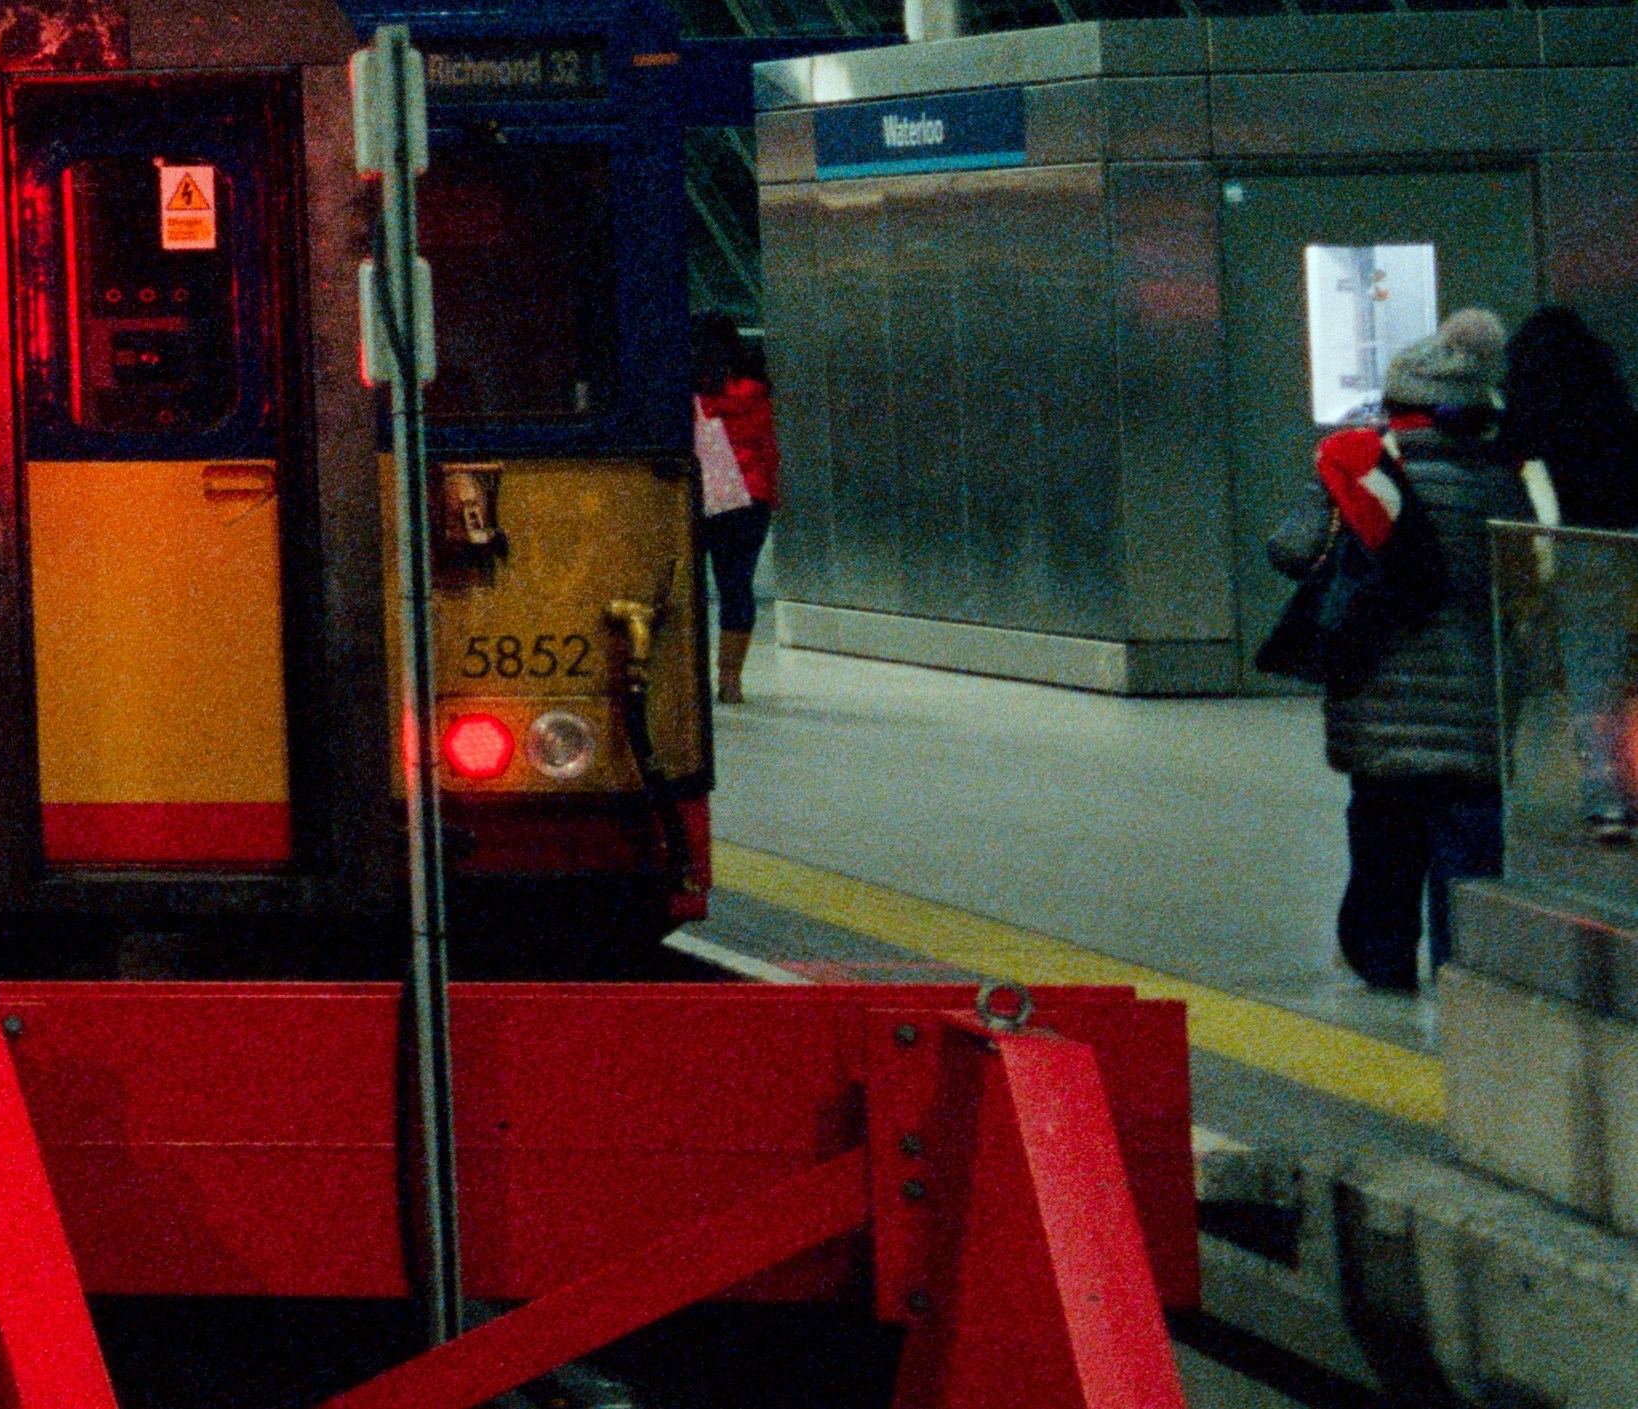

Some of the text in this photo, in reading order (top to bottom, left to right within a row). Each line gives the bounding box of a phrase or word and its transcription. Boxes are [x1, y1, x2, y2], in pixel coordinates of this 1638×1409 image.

[427, 51, 541, 86] Richmond
[882, 112, 944, 147] Waterloo
[462, 634, 592, 679] 5852
